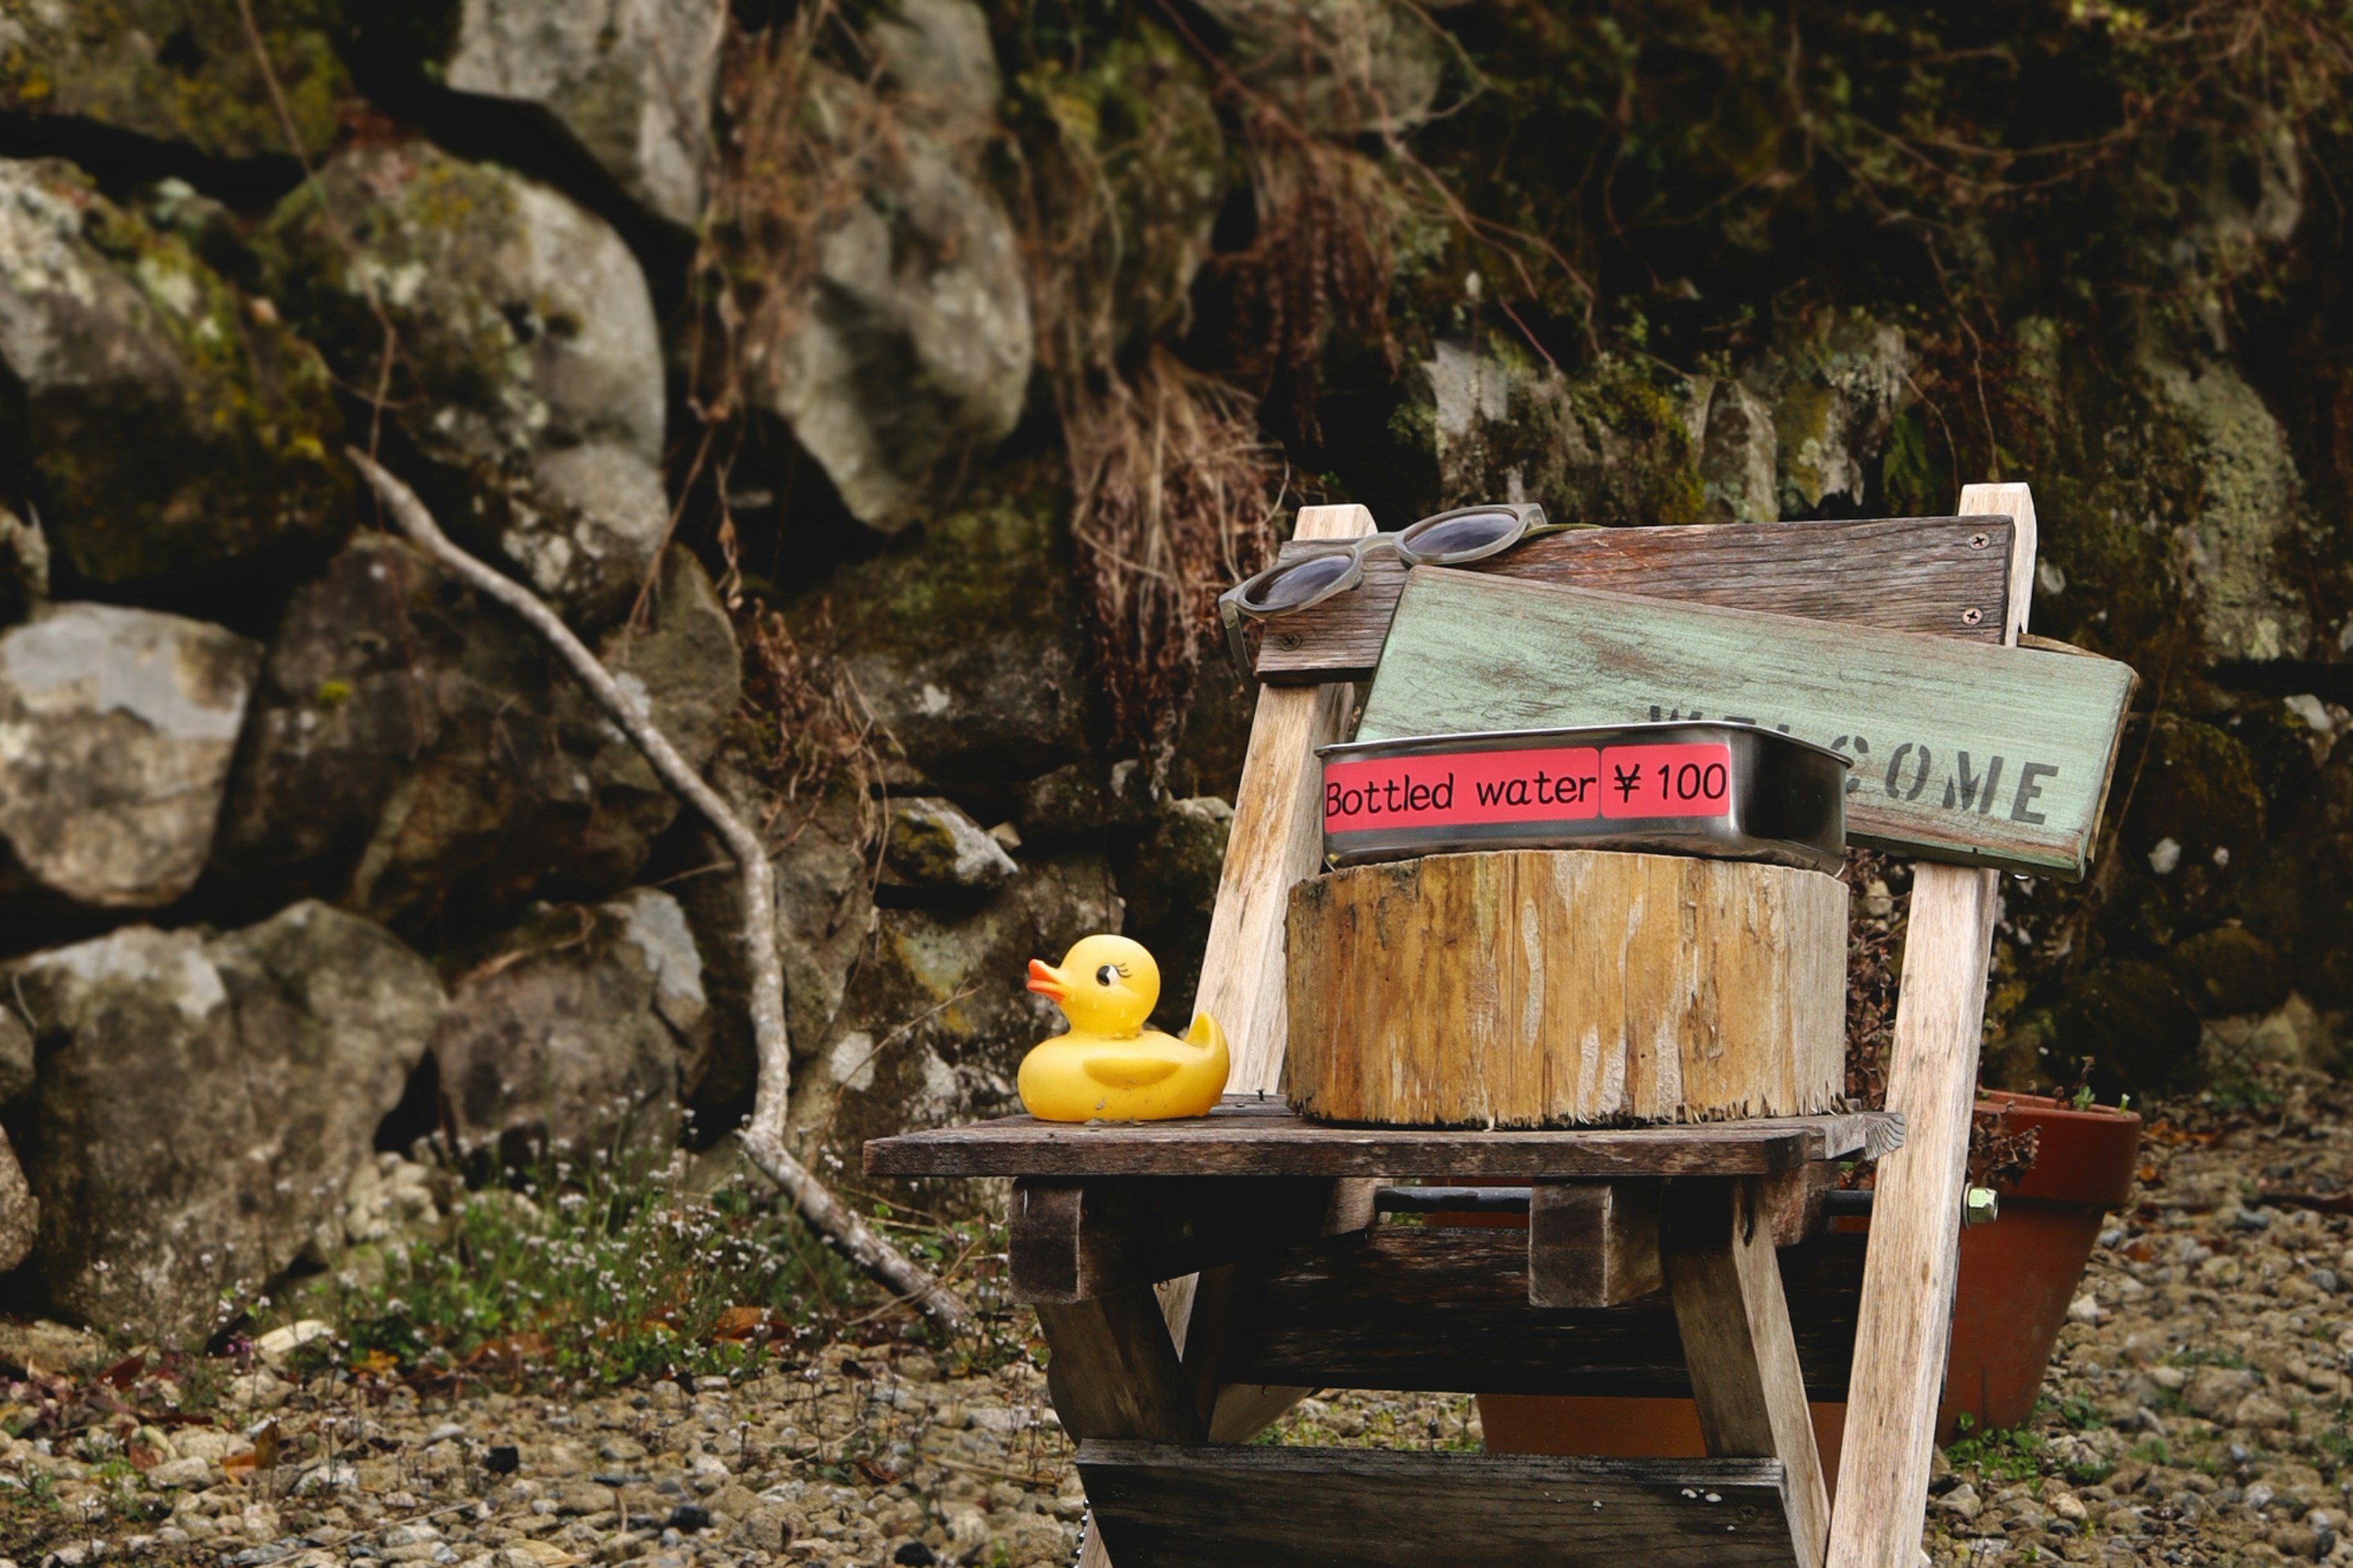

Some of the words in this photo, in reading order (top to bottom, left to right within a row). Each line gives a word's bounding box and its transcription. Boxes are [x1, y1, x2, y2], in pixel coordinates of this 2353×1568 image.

[1325, 773, 1454, 817] Bottled
[1476, 770, 1597, 807] water
[1657, 762, 1728, 801] 100
[1650, 705, 2059, 825] COME
